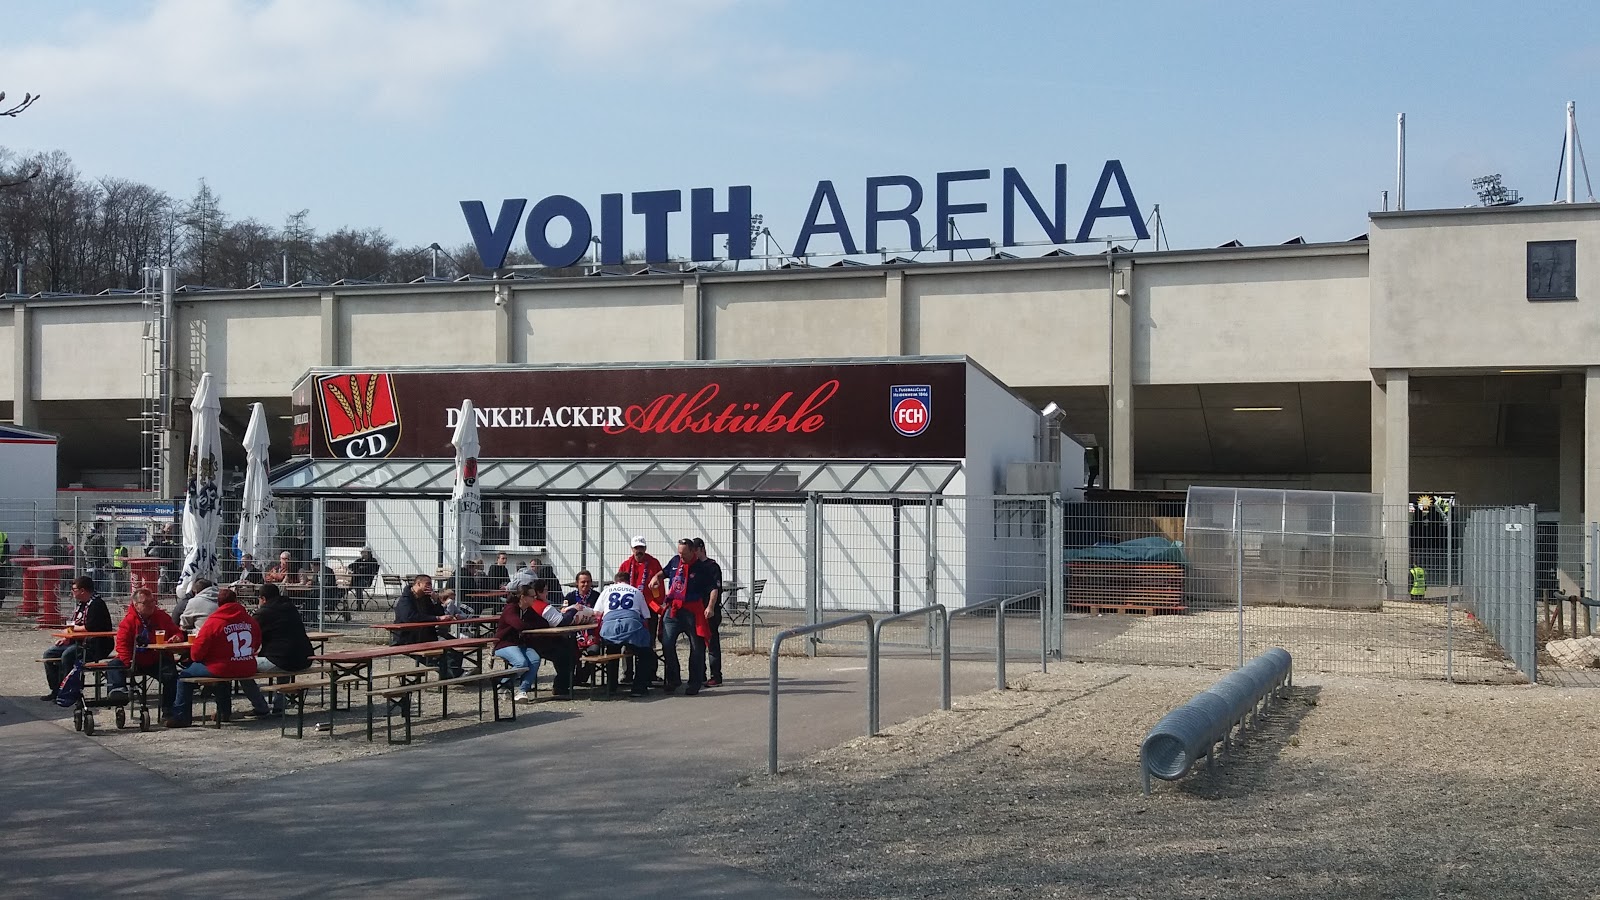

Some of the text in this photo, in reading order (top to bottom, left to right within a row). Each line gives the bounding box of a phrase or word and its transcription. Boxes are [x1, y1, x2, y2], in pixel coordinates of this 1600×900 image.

[459, 159, 1151, 269] VOITH ARENA
[445, 379, 840, 435] DNKELACKER Albstüble
[898, 408, 923, 424] FCH
[345, 433, 387, 459] CD
[608, 592, 634, 610] 86
[223, 621, 252, 634] OSTTRIBÜNE
[226, 630, 252, 658] 12
